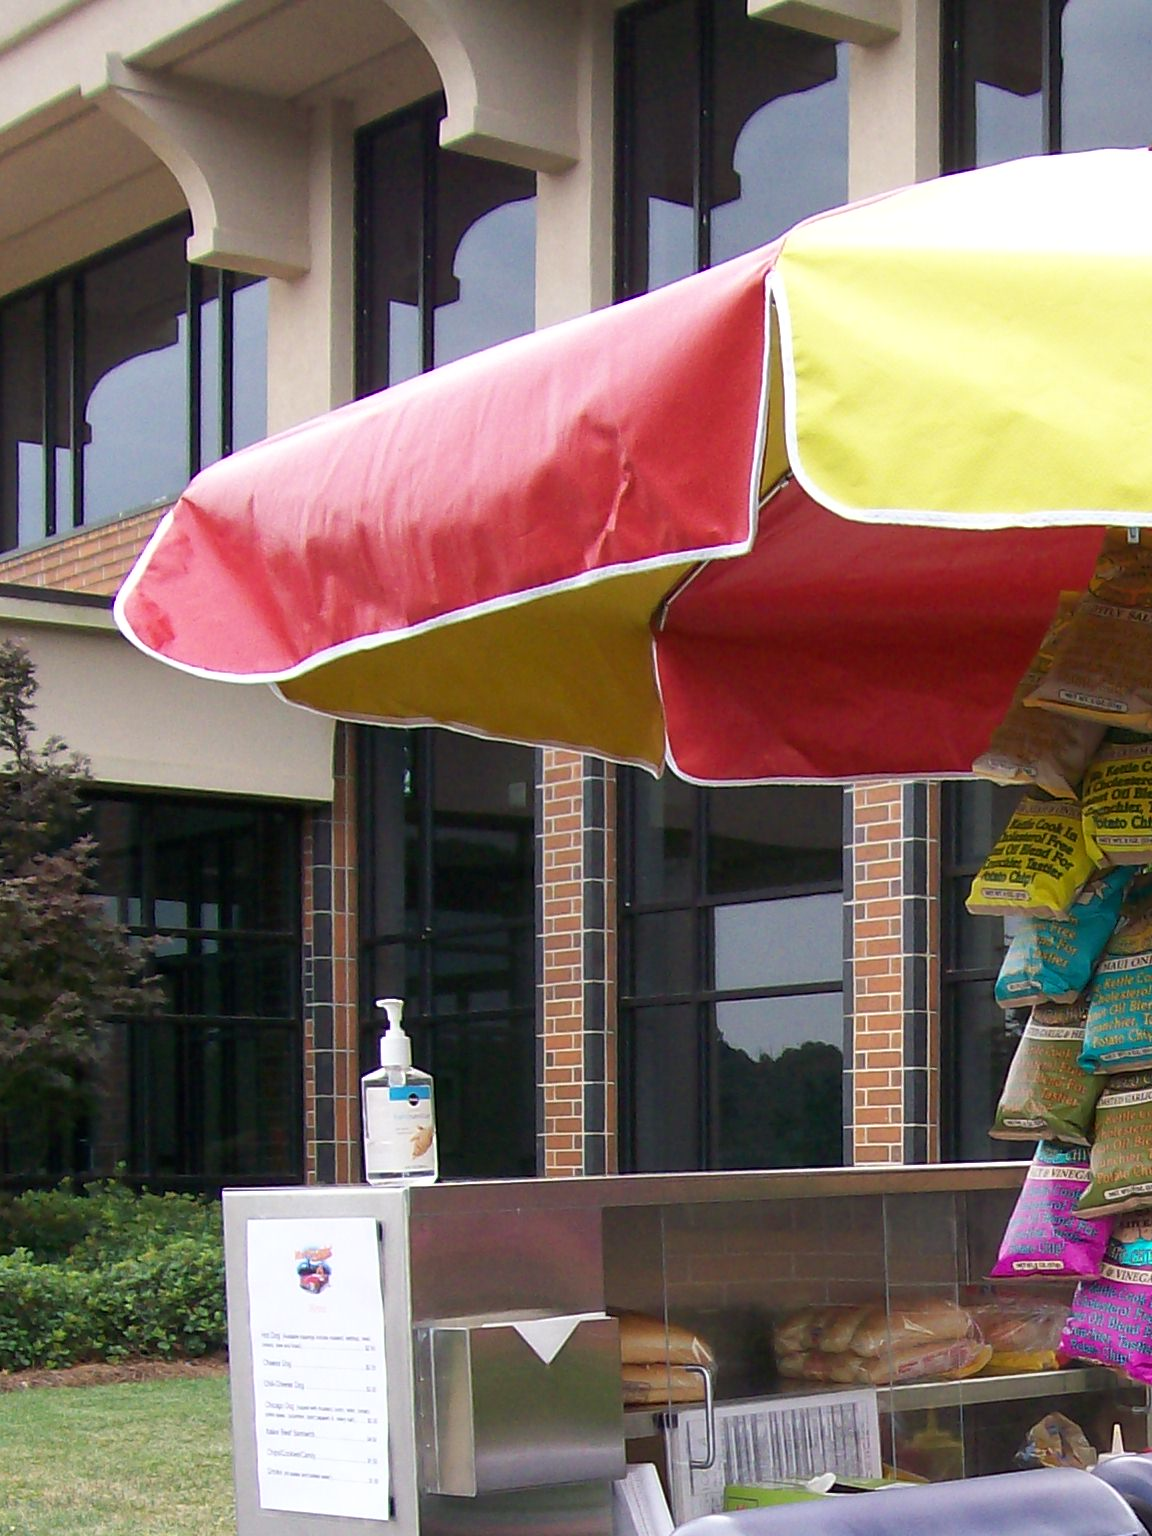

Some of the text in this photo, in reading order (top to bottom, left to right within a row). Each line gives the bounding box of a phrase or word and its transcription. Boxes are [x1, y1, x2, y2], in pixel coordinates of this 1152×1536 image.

[1035, 819, 1064, 834] Cook
[1051, 849, 1075, 871] For
[1050, 1167, 1092, 1180] VINEGA
